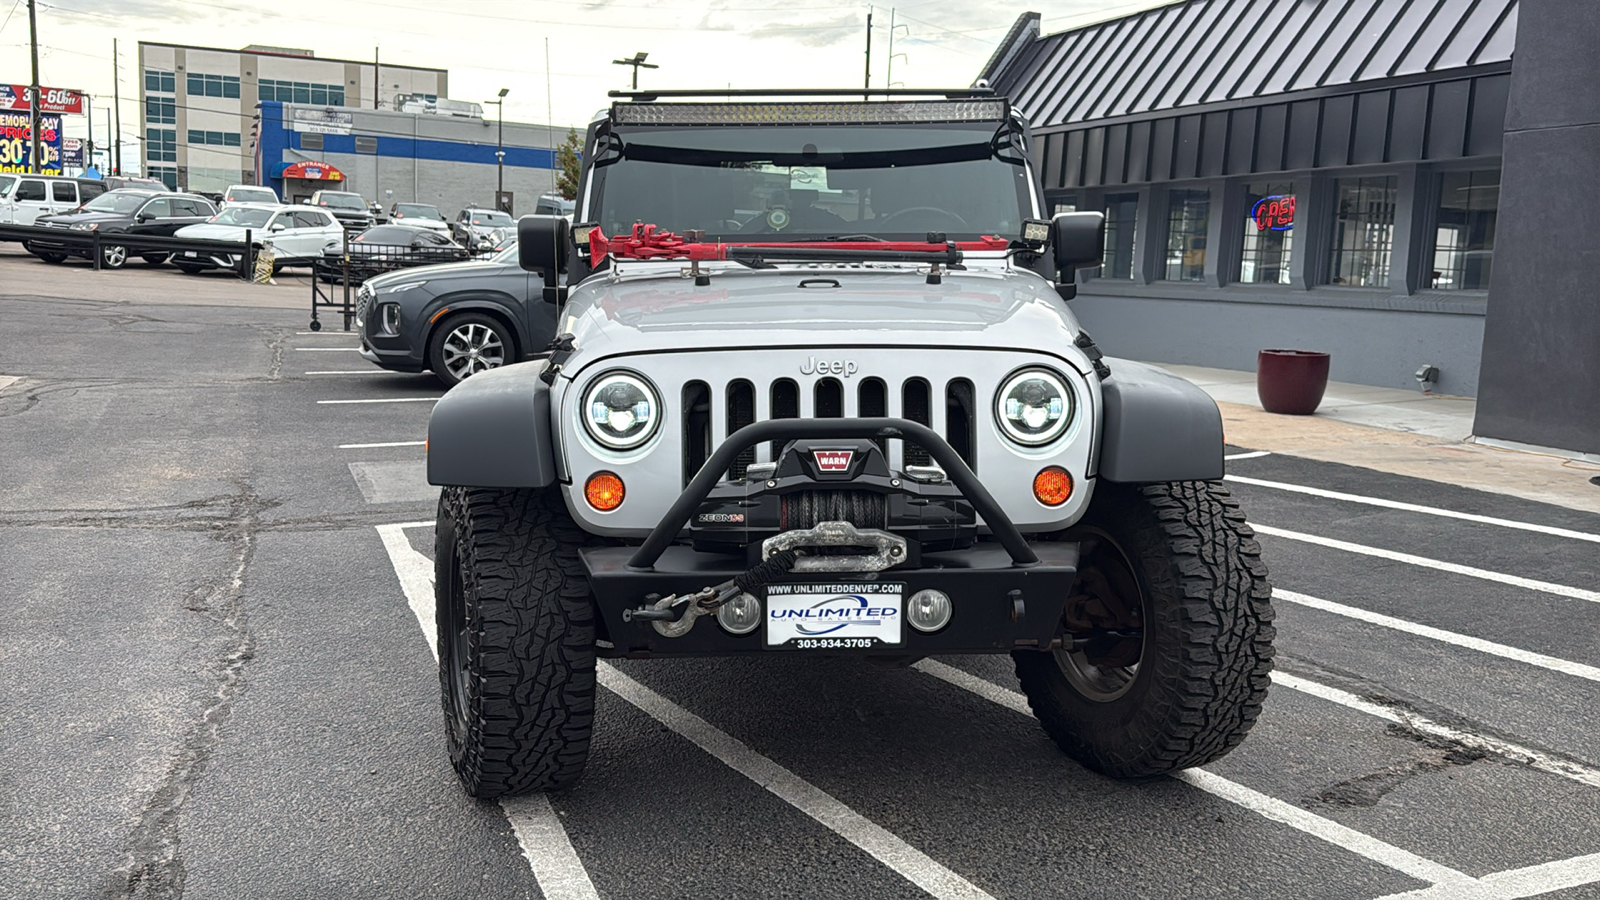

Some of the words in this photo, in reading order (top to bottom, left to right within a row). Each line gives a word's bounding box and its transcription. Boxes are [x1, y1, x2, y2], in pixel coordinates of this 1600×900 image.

[297, 161, 330, 170] ENTRANCE
[800, 355, 858, 378] Jeep
[820, 457, 847, 465] WARN
[767, 584, 902, 594] WWW.UNLIMITEDDENVER.COM
[770, 607, 898, 619] UNLIMITED
[797, 639, 872, 648] 303-934-3705
